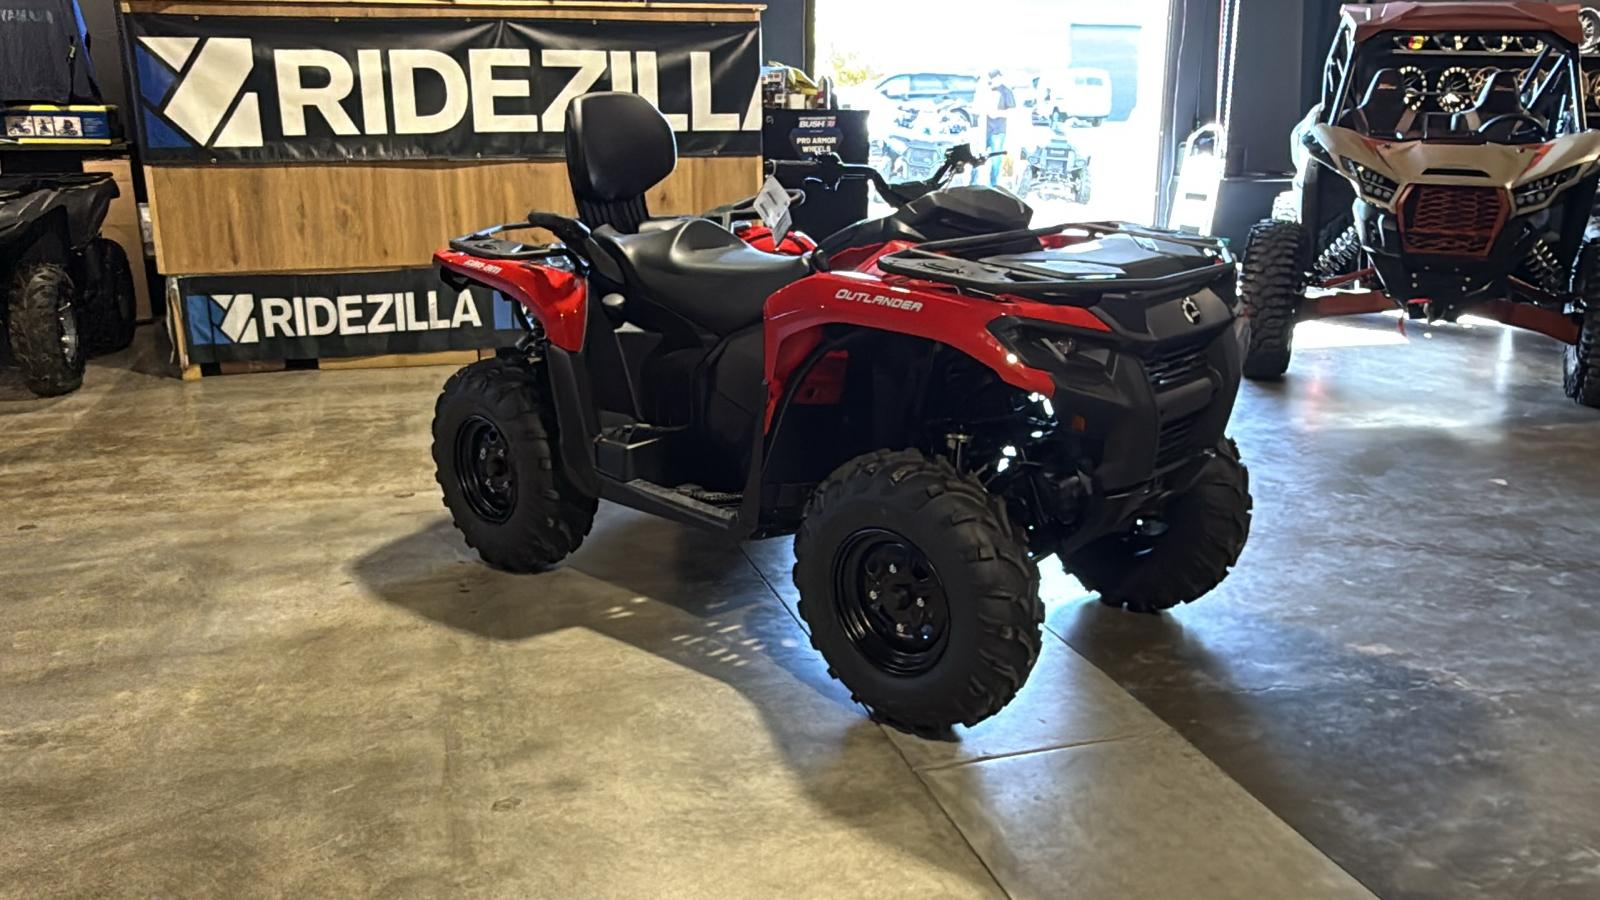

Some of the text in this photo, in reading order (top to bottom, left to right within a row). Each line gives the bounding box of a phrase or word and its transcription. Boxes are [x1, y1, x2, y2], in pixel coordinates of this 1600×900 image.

[274, 48, 762, 135] RIDEZILL
[260, 289, 483, 338] RIDEZILLA
[835, 289, 923, 312] OUTLANDER
